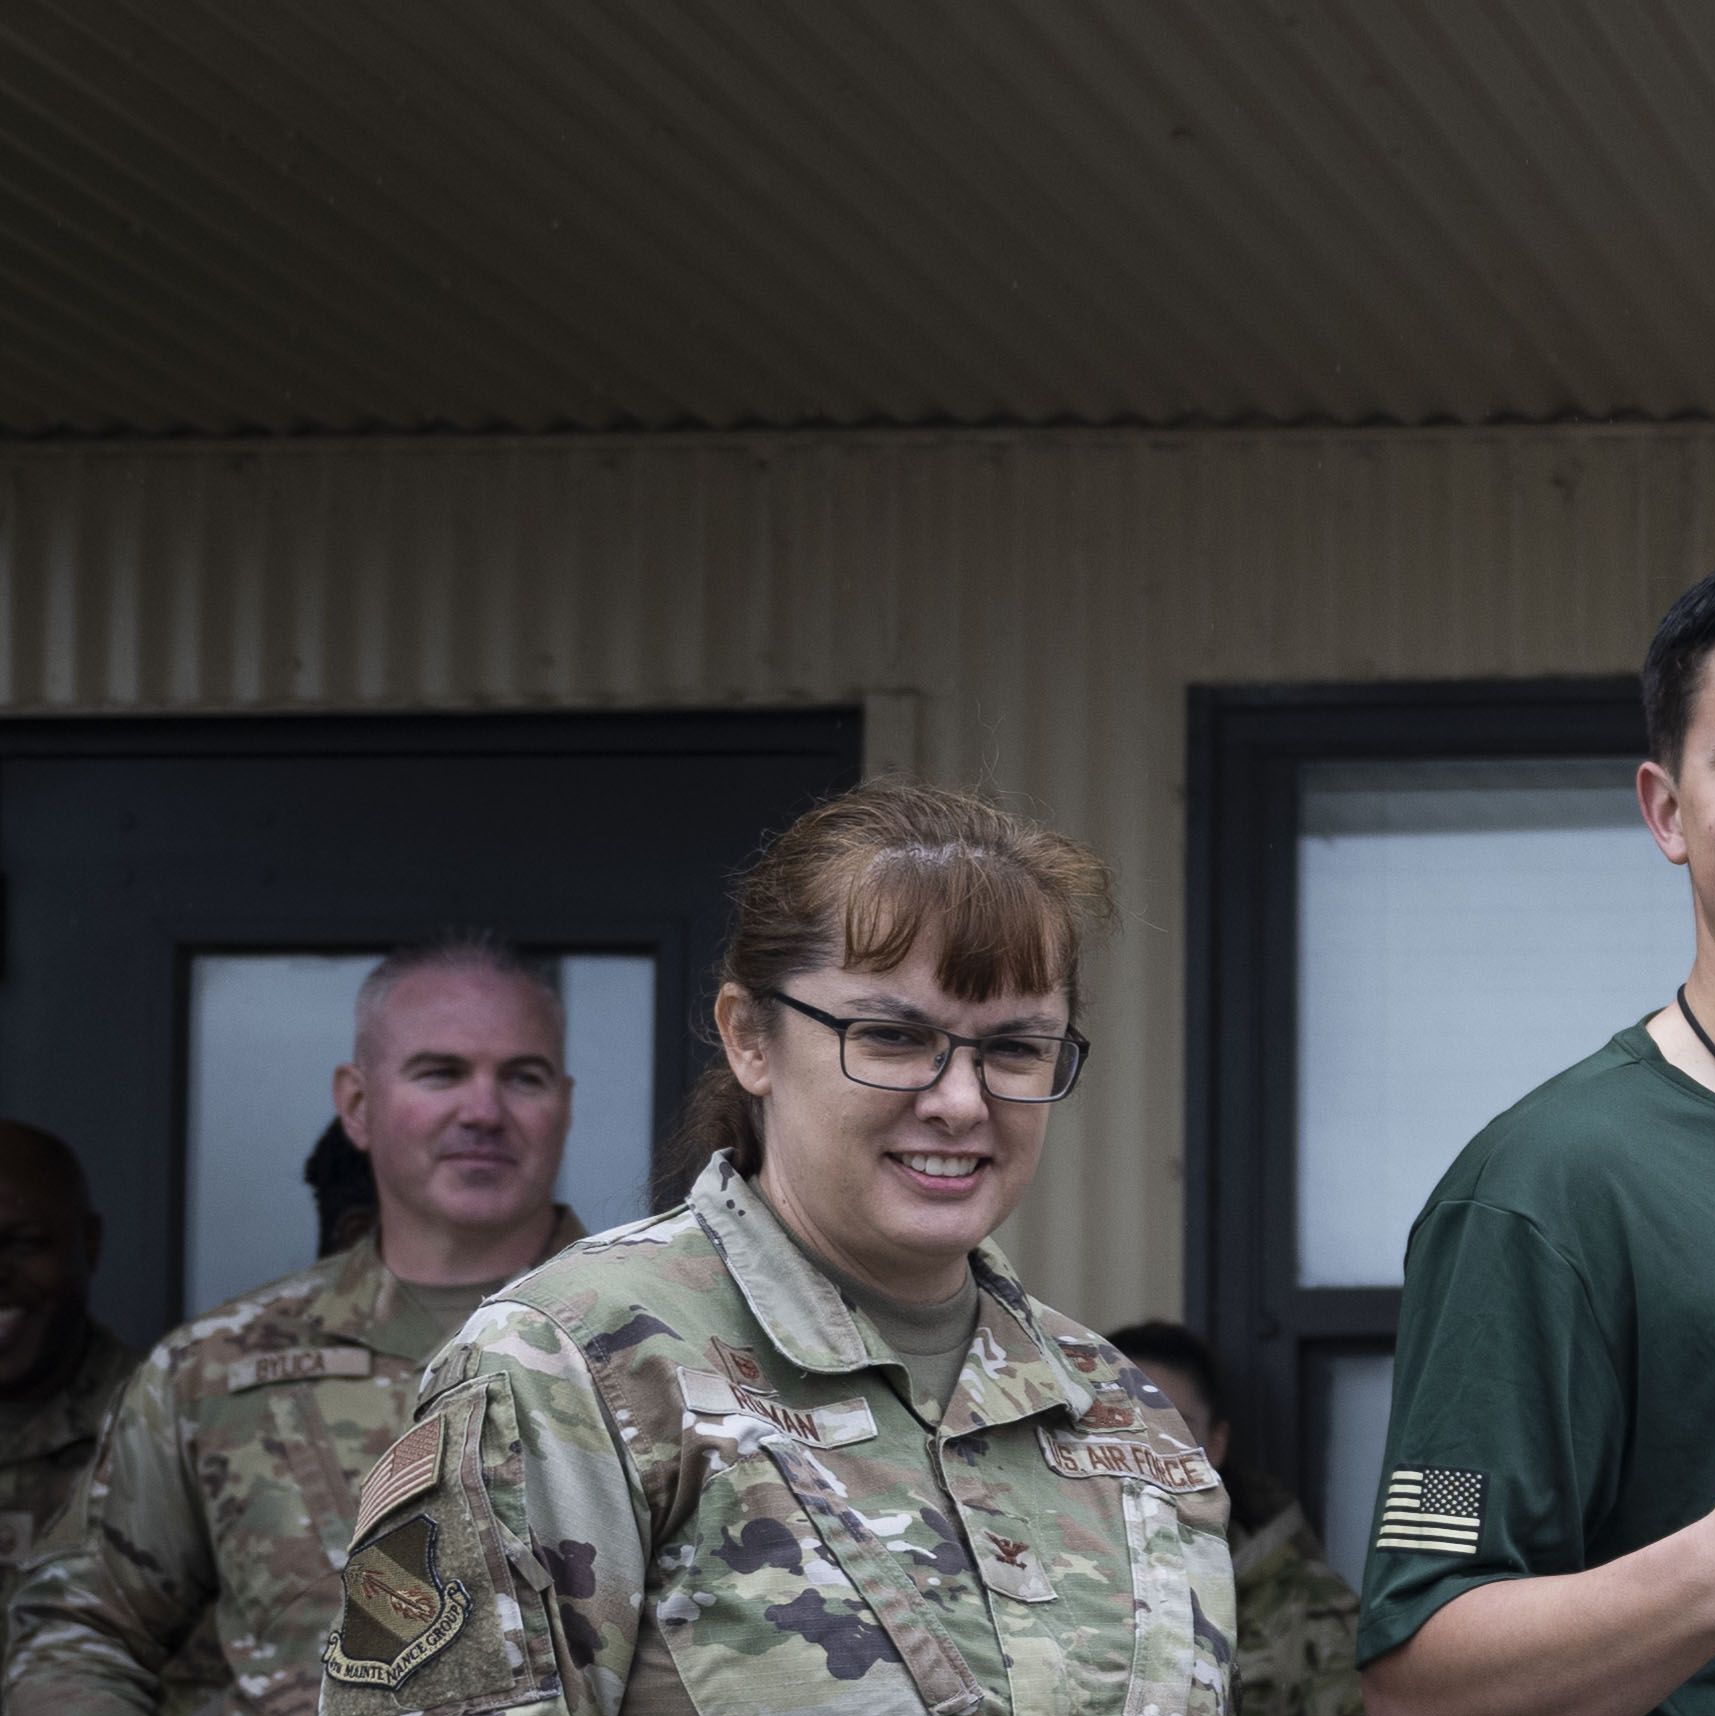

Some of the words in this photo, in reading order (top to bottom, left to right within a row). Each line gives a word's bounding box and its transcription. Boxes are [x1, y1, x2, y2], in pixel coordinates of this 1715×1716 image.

[1086, 1444, 1133, 1473] AIR
[1130, 1446, 1205, 1487] FORCE
[344, 1641, 427, 1684] MAINTENANCE
[426, 1604, 460, 1647] GROUP
